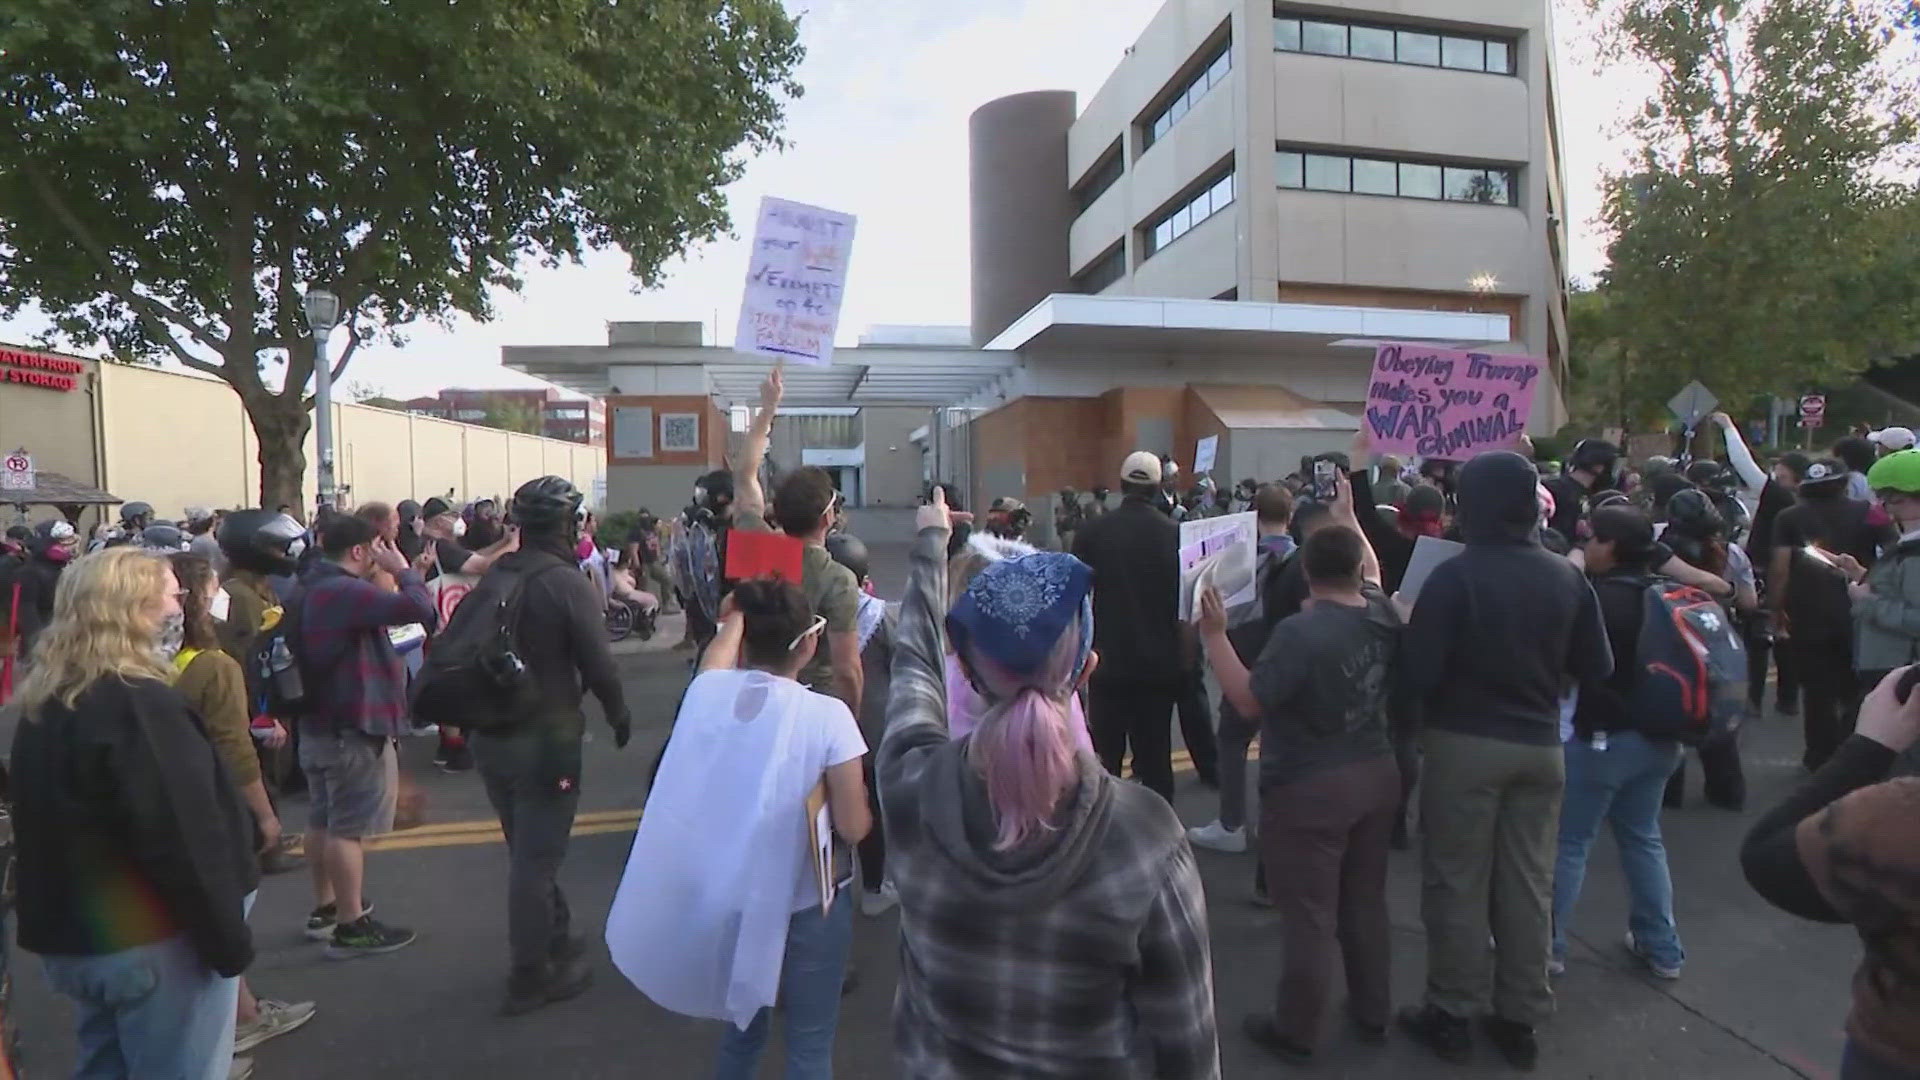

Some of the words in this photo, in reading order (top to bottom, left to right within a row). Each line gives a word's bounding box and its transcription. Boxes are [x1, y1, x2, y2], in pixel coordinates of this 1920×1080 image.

[9, 368, 78, 391] STORAGE
[1378, 346, 1454, 386] Obeying
[1467, 353, 1538, 390] Trump
[1438, 388, 1483, 414] you
[1493, 393, 1510, 411] a
[1367, 404, 1442, 440] WAR
[1417, 409, 1524, 456] CRIMINAL
